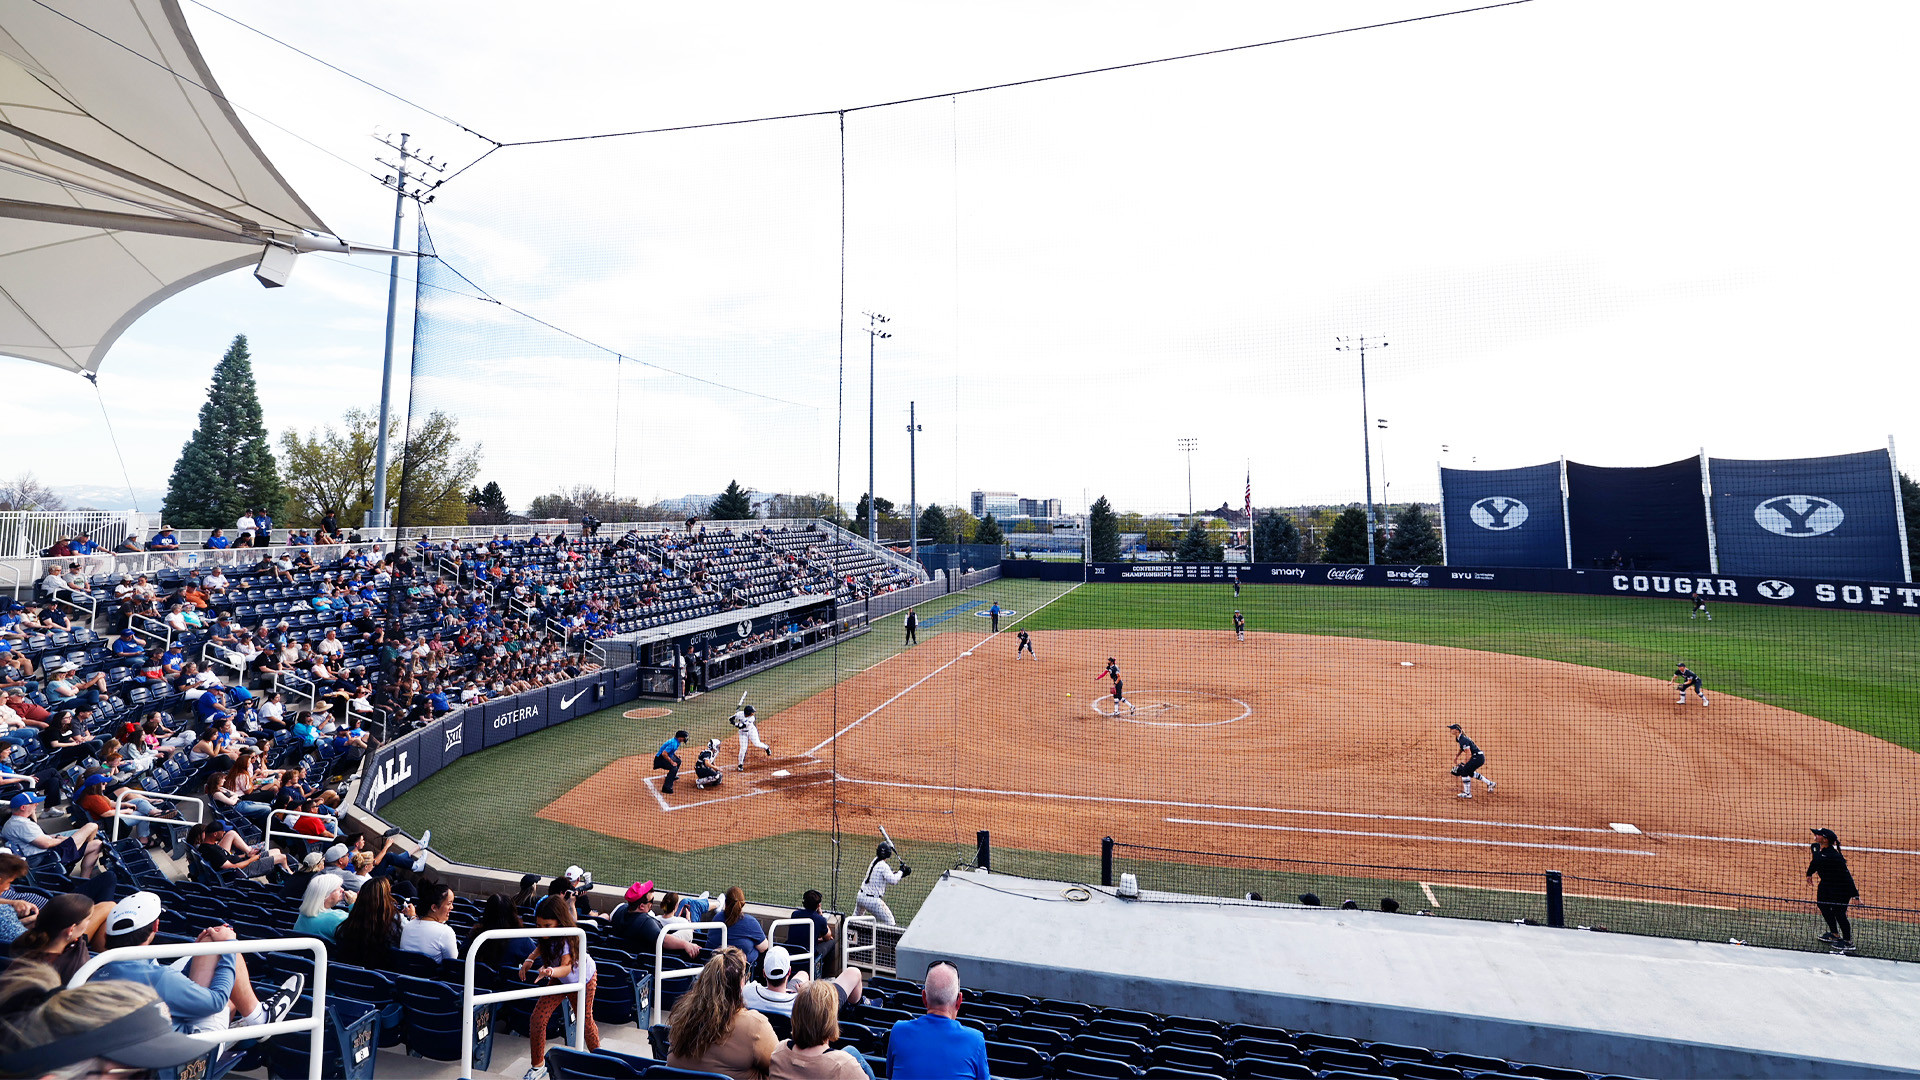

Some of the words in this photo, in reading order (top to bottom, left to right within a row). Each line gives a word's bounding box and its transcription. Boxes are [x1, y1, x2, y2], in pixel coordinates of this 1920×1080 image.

[1271, 568, 1306, 578] smarty
[1387, 570, 1429, 579] Breeze
[1451, 572, 1472, 580] BYU
[1612, 575, 1738, 596] COUGAR
[1815, 583, 1920, 607] SOFT
